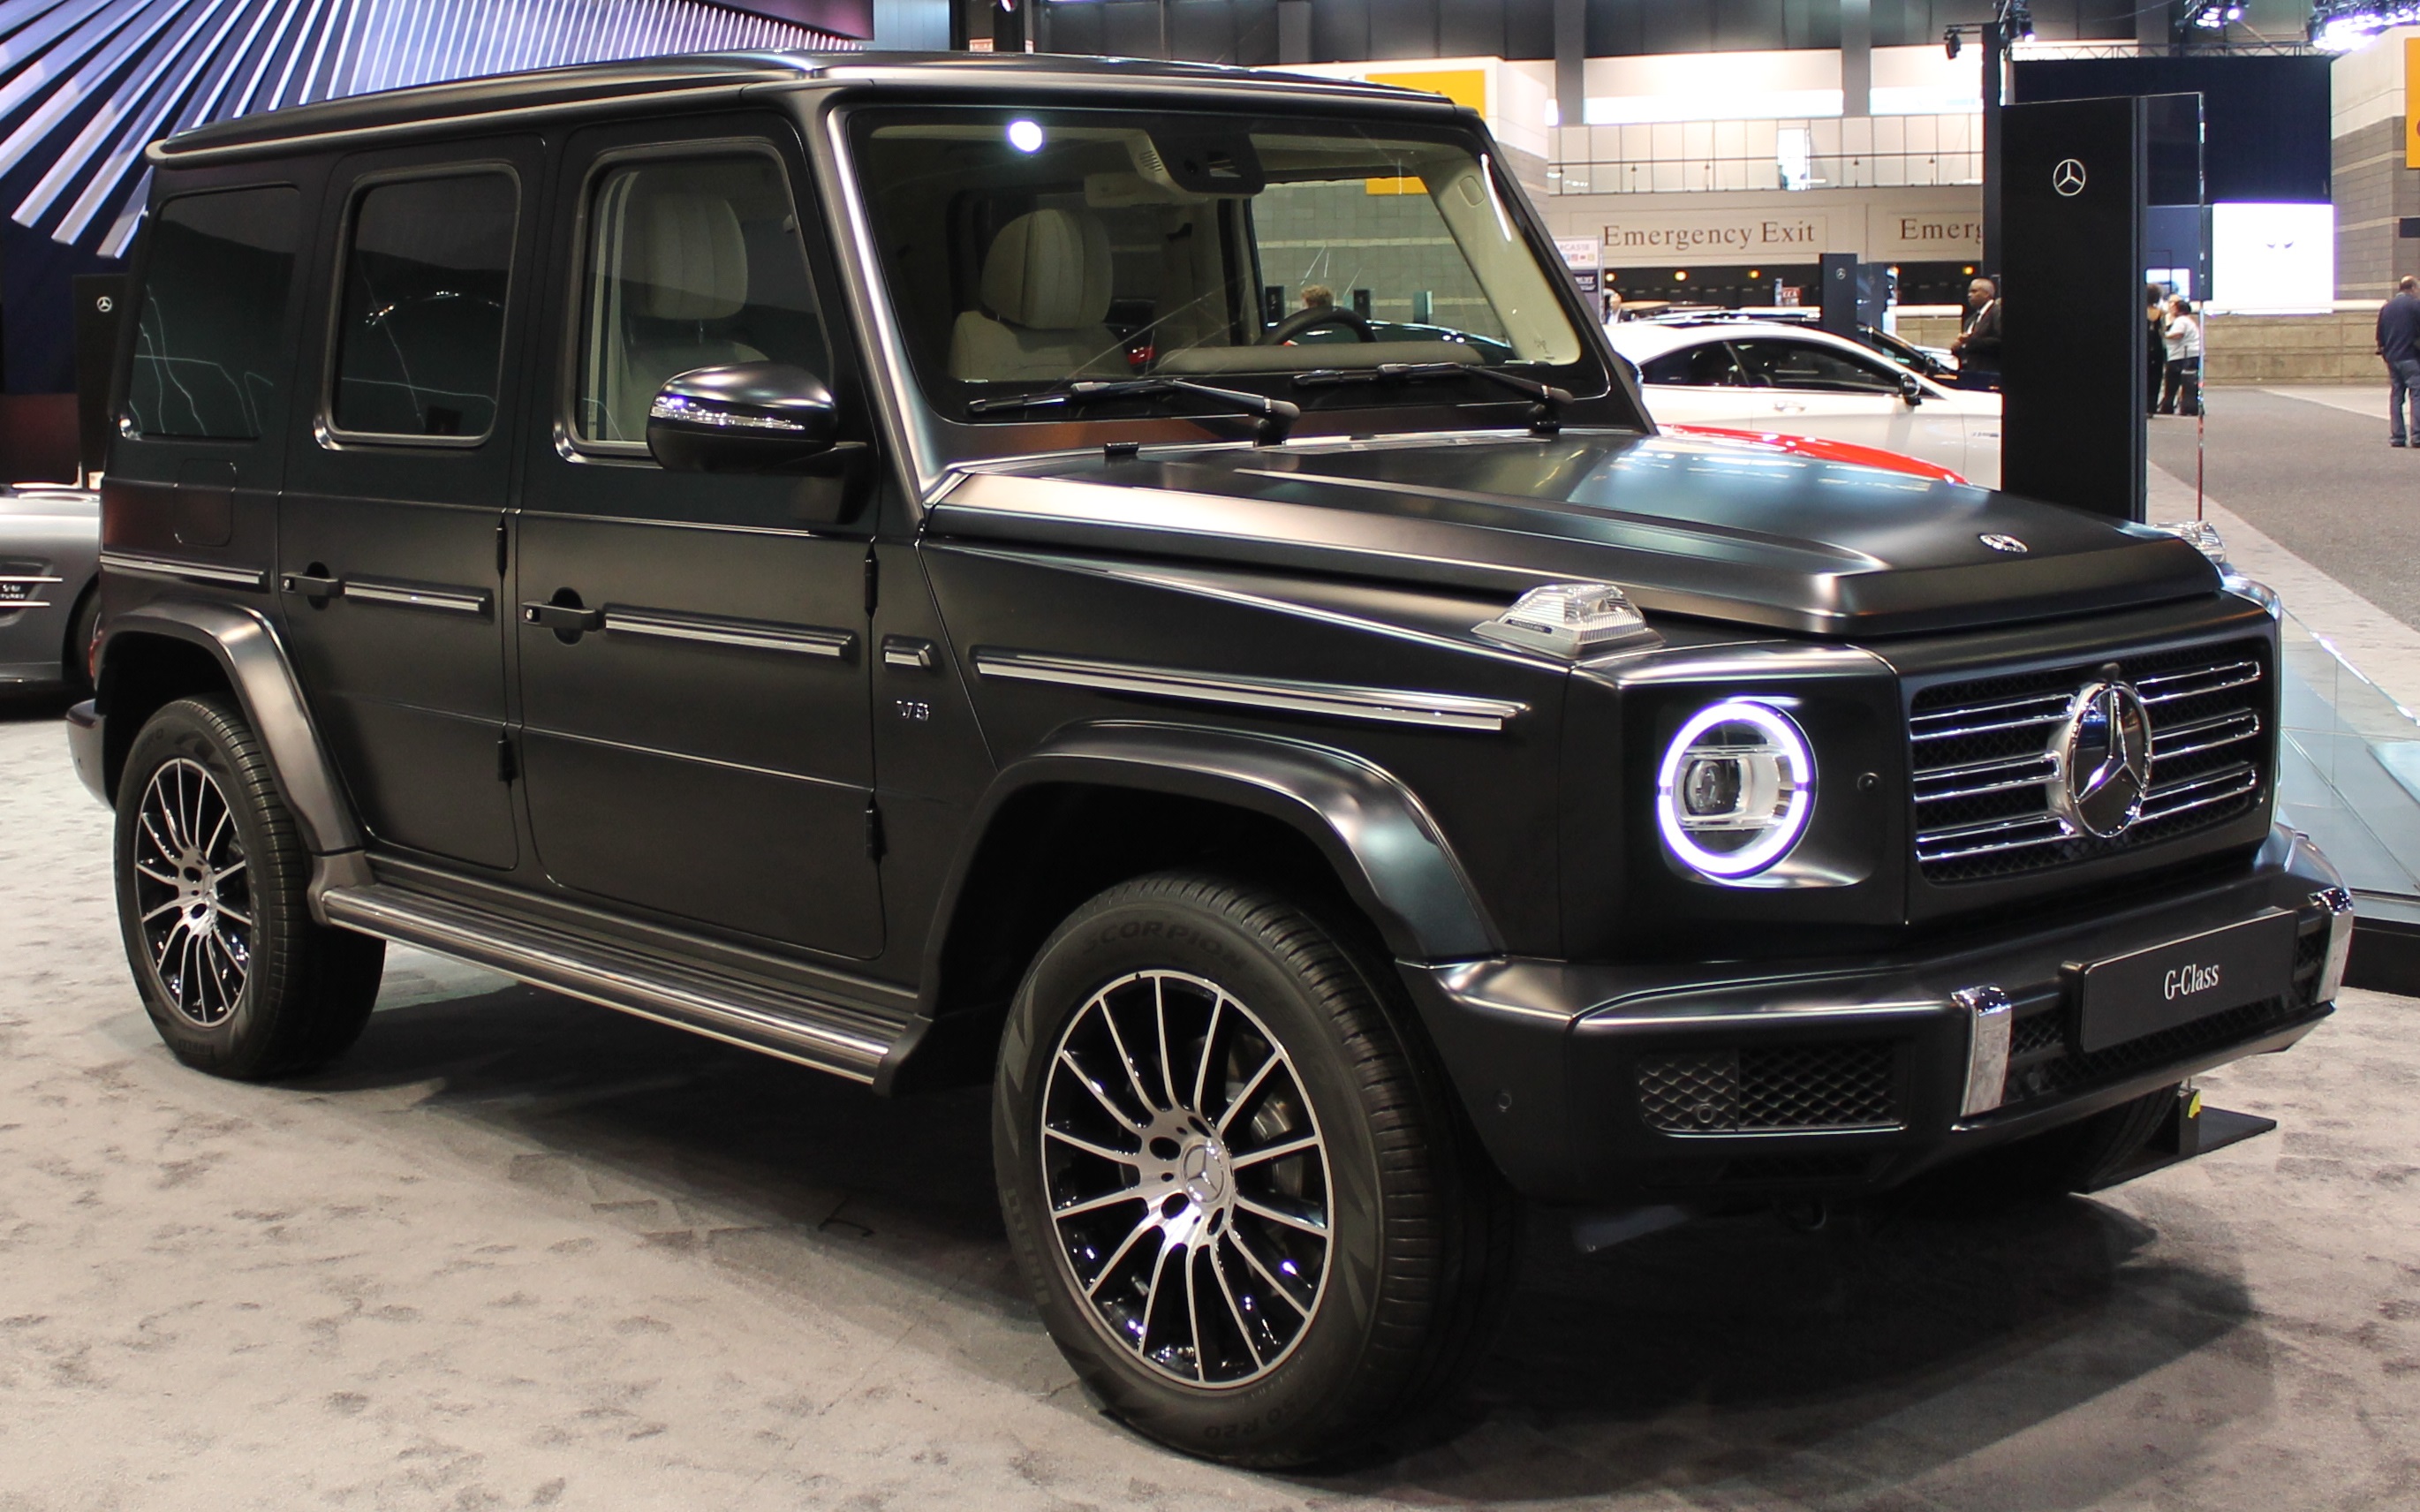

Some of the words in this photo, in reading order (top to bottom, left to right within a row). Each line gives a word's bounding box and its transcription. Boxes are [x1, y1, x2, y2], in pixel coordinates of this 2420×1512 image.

[1603, 224, 1752, 251] Emergency
[1761, 221, 1816, 243] Exit
[896, 700, 929, 721] V8
[1082, 920, 1249, 970] SCORPION
[2164, 964, 2220, 1001] G-Class
